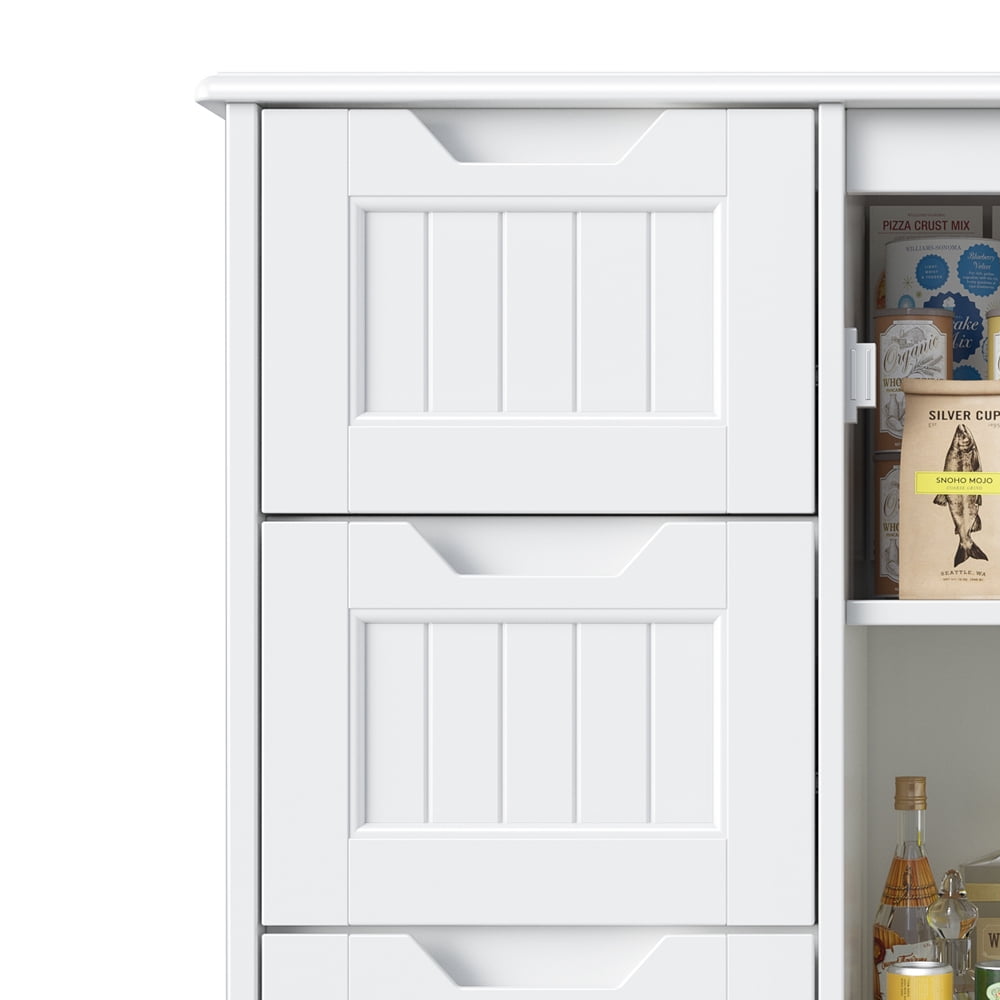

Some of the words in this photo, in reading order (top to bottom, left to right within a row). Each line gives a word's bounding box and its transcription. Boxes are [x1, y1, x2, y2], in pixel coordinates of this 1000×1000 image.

[882, 220, 911, 230] PIZZA
[914, 220, 948, 230] CRUST
[951, 220, 970, 230] MIX
[883, 334, 938, 374] Organic
[928, 410, 971, 421] SILVER
[975, 410, 1000, 421] CUP
